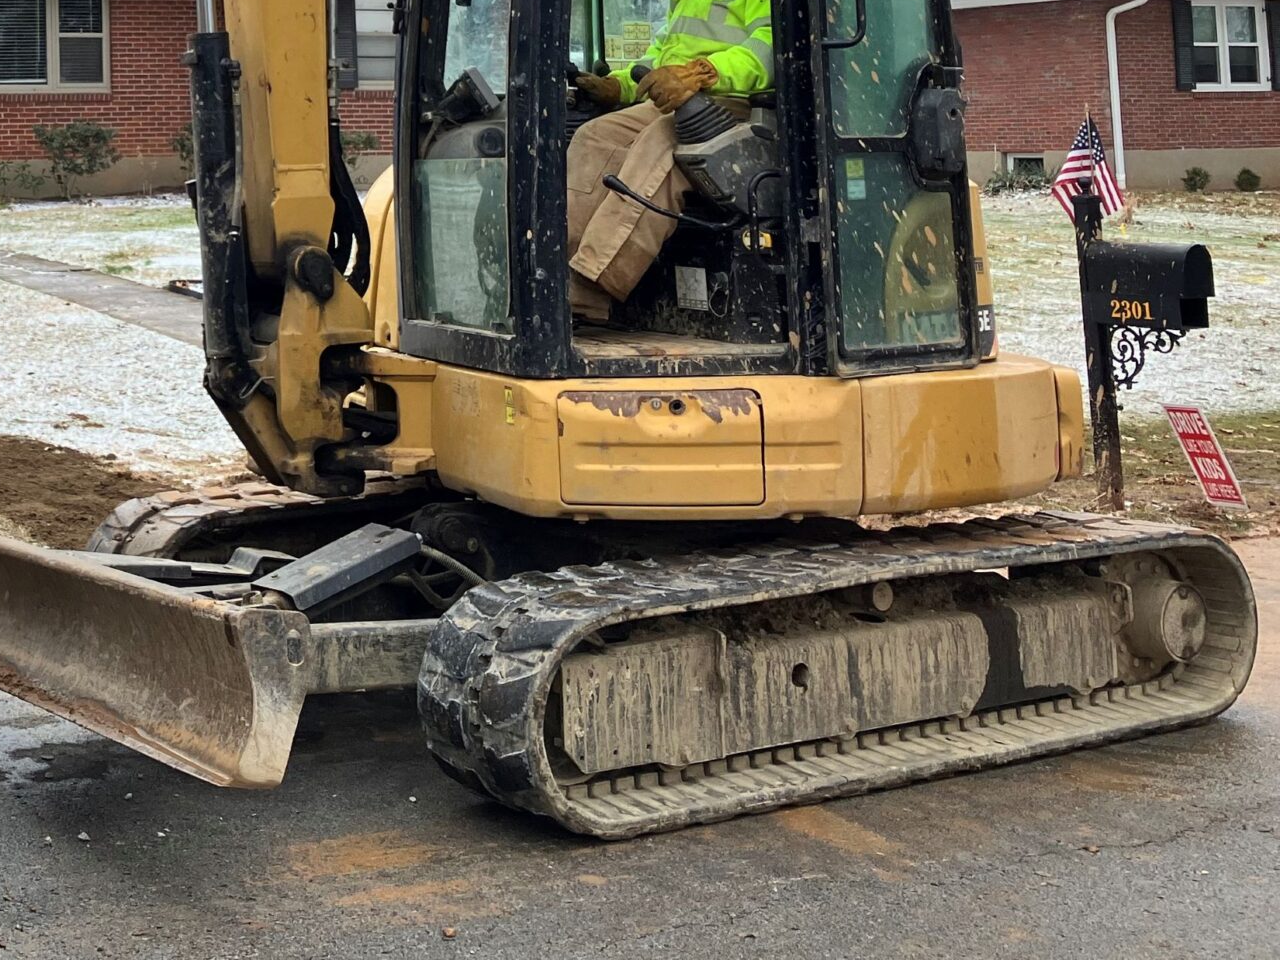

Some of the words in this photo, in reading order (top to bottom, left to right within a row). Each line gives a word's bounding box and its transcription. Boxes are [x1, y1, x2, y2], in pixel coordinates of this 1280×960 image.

[1110, 300, 1153, 320] 2301
[1168, 411, 1209, 436] DRIVE
[1183, 438, 1201, 453] LIKE
[1197, 439, 1219, 455] YOUR
[1194, 456, 1226, 481] KIDS
[1204, 482, 1221, 497] LIVE
[1218, 483, 1240, 499] HERE
